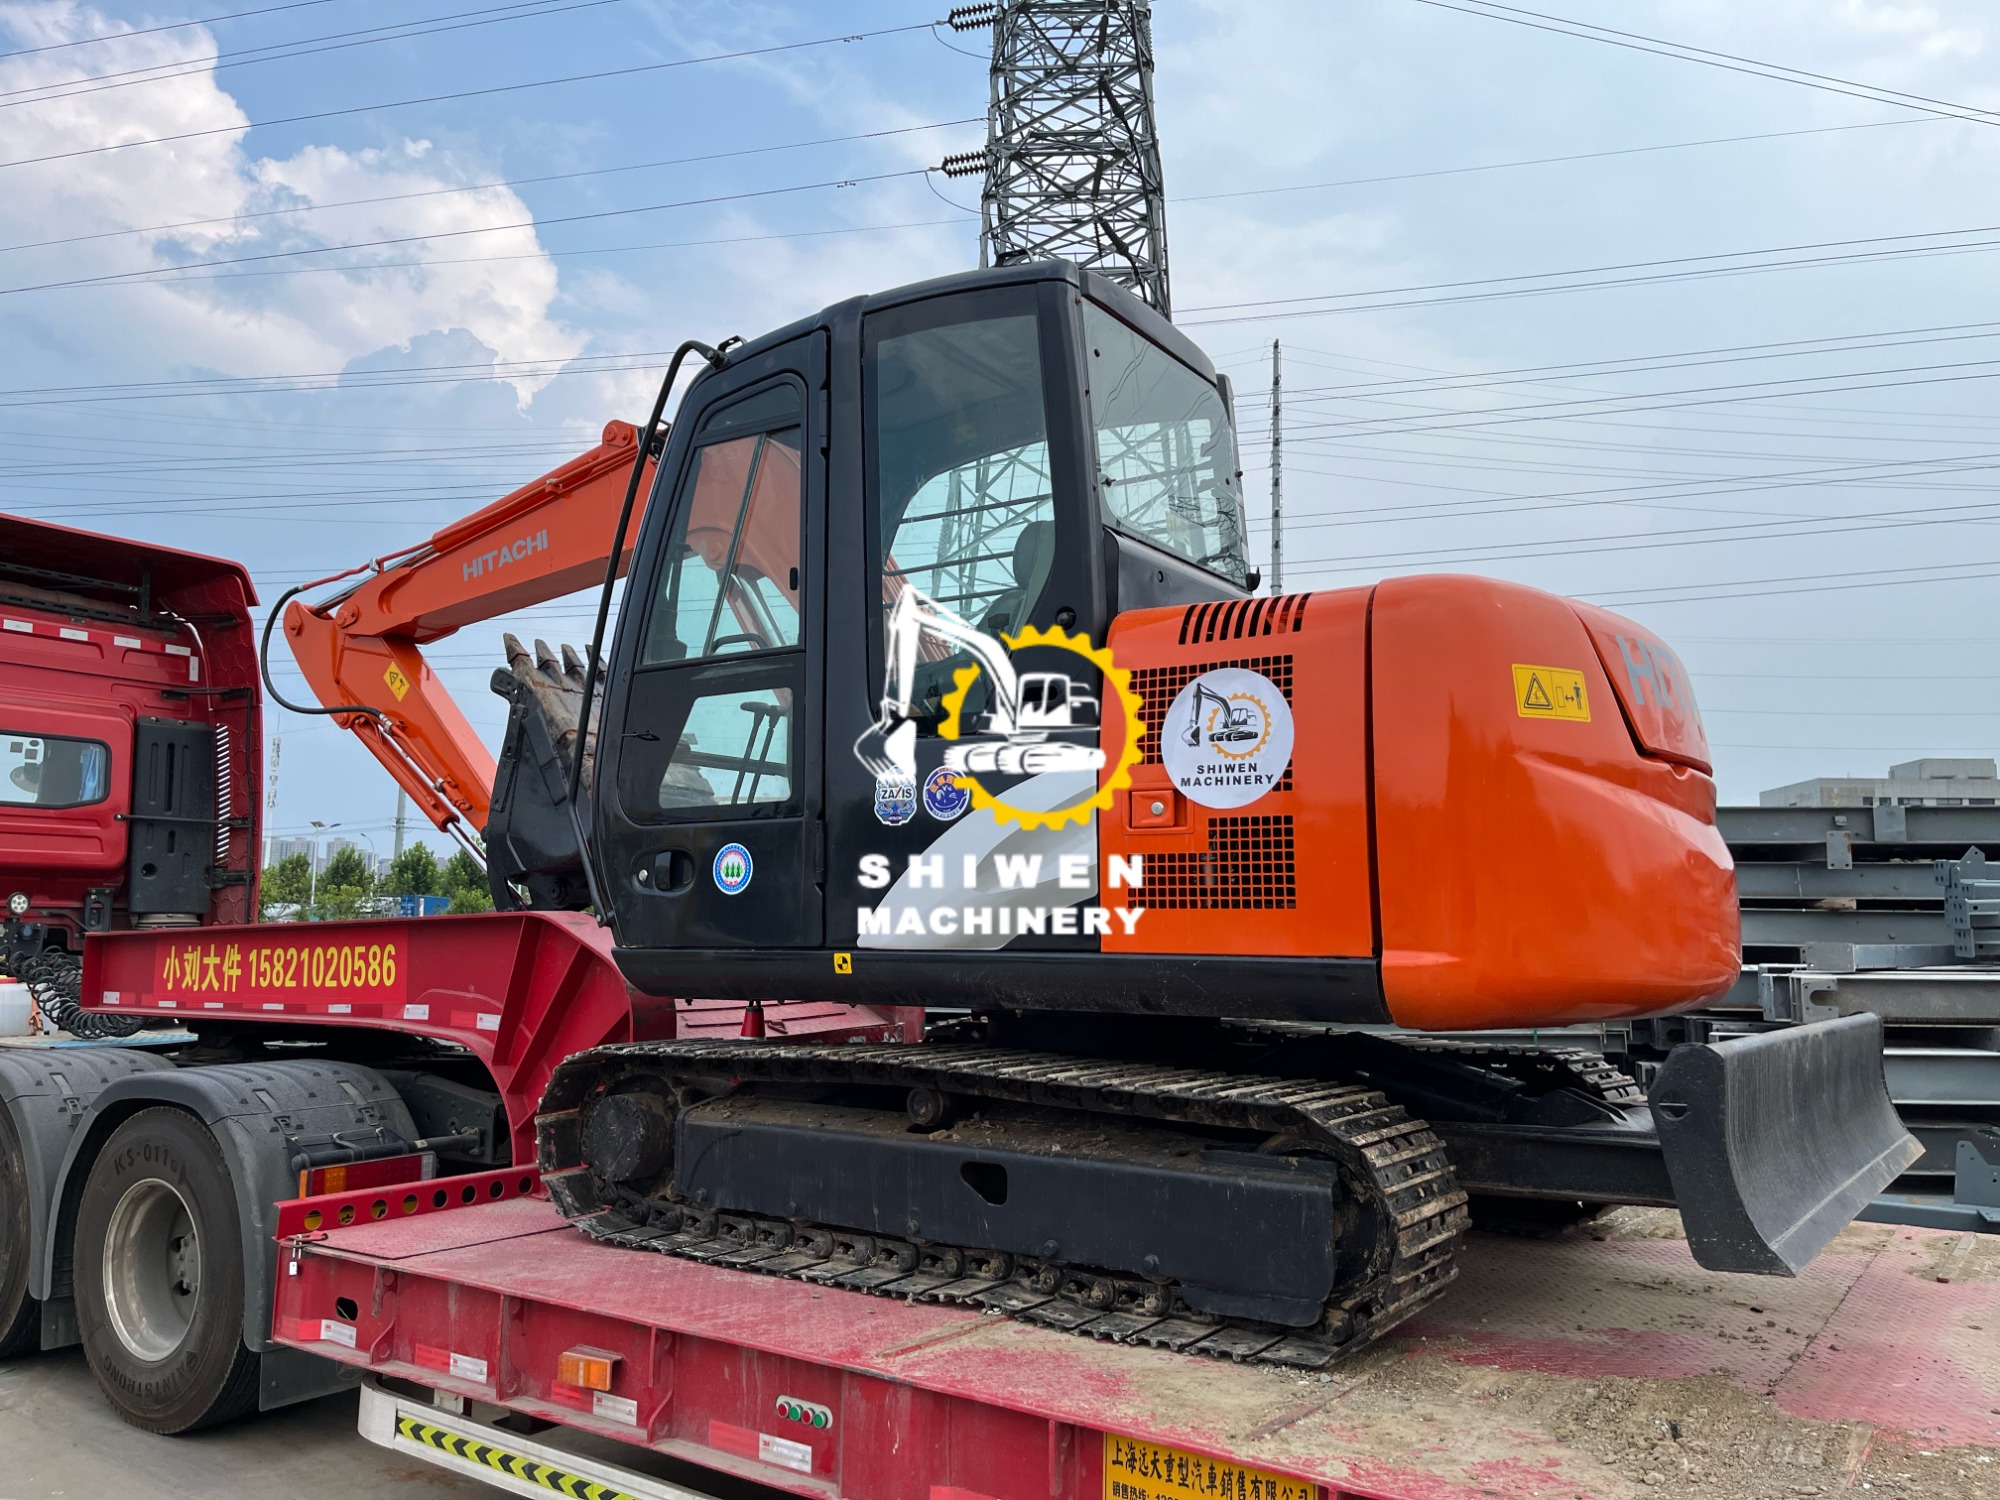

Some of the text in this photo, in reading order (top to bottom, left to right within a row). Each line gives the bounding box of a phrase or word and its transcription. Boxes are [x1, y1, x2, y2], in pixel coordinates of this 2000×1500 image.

[463, 529, 548, 582] HITACHI
[1197, 762, 1257, 774] SHIWEN
[1180, 774, 1274, 787] MACHINERY
[881, 787, 912, 800] ZAXIS
[163, 943, 396, 992] 小刘大件 15821020586
